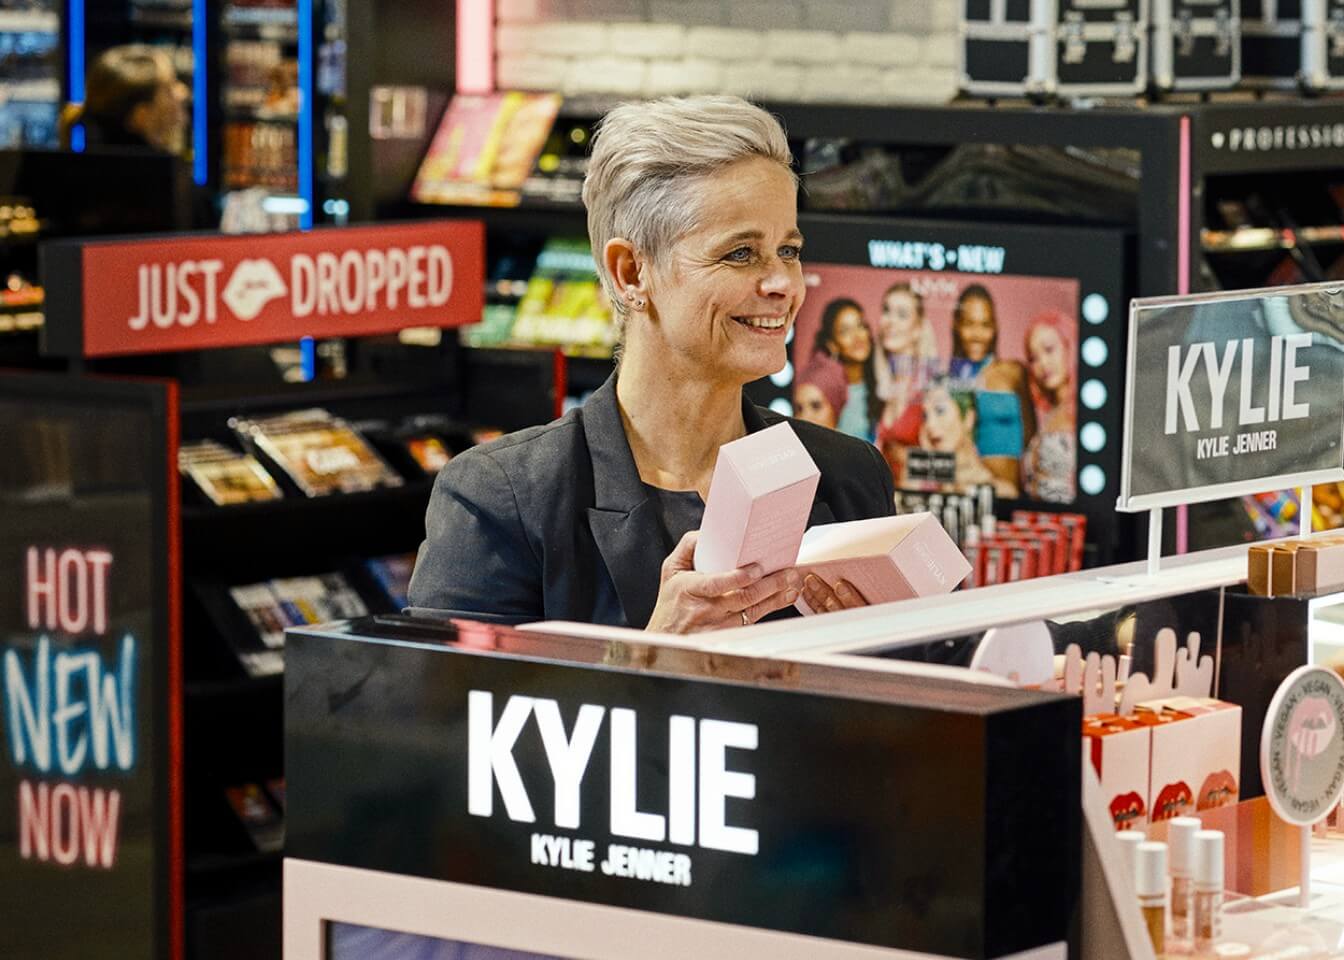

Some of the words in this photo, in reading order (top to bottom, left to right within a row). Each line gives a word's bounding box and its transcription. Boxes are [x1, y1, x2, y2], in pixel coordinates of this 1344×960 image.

[128, 259, 223, 331] JUST
[291, 246, 453, 317] DROPPED
[868, 239, 946, 271] WHAT'S
[957, 245, 1006, 274] NEW
[1164, 332, 1313, 435] KYLIE
[1196, 436, 1230, 460] KYLIE
[1232, 430, 1277, 455] JENNER
[27, 546, 113, 635] HOT
[4, 633, 136, 775] NEW
[1277, 694, 1297, 740] VEGAN
[1301, 679, 1332, 696] VEGAN
[468, 689, 759, 855] KYLIE
[19, 779, 121, 870] NOW
[530, 833, 596, 872] KYLIE
[600, 843, 692, 887] JENNER
